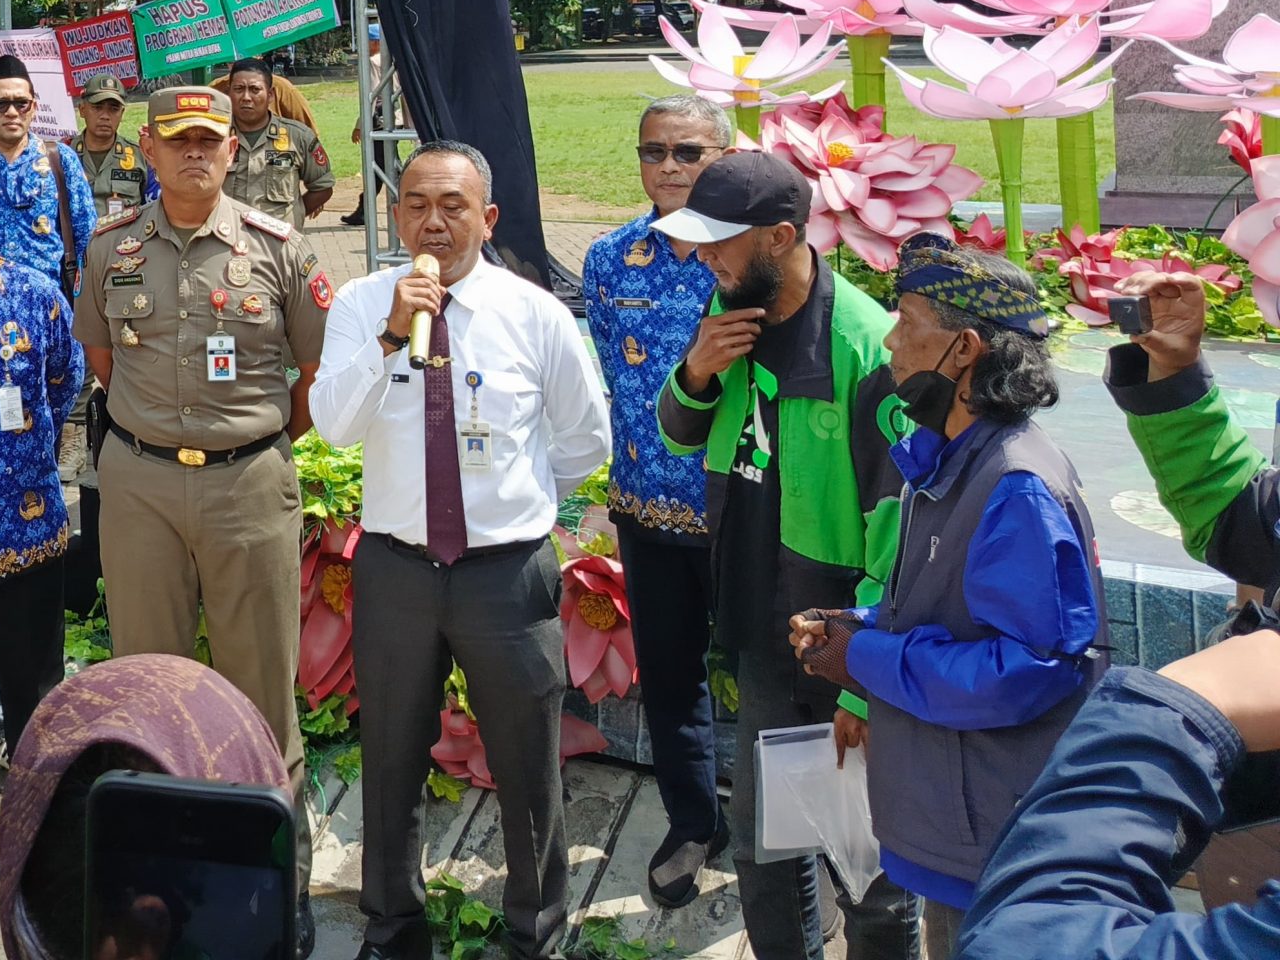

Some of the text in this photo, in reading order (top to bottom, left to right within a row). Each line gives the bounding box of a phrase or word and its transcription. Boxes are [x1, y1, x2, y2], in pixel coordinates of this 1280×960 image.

[233, 1, 277, 30] POTONGAN
[62, 18, 130, 48] WUJUDKAN
[144, 15, 228, 52] PROGRAM HEMAT
[20, 39, 60, 60] SOLORAYA
[67, 46, 100, 68] UNDANG
[102, 38, 133, 62] UNDANG
